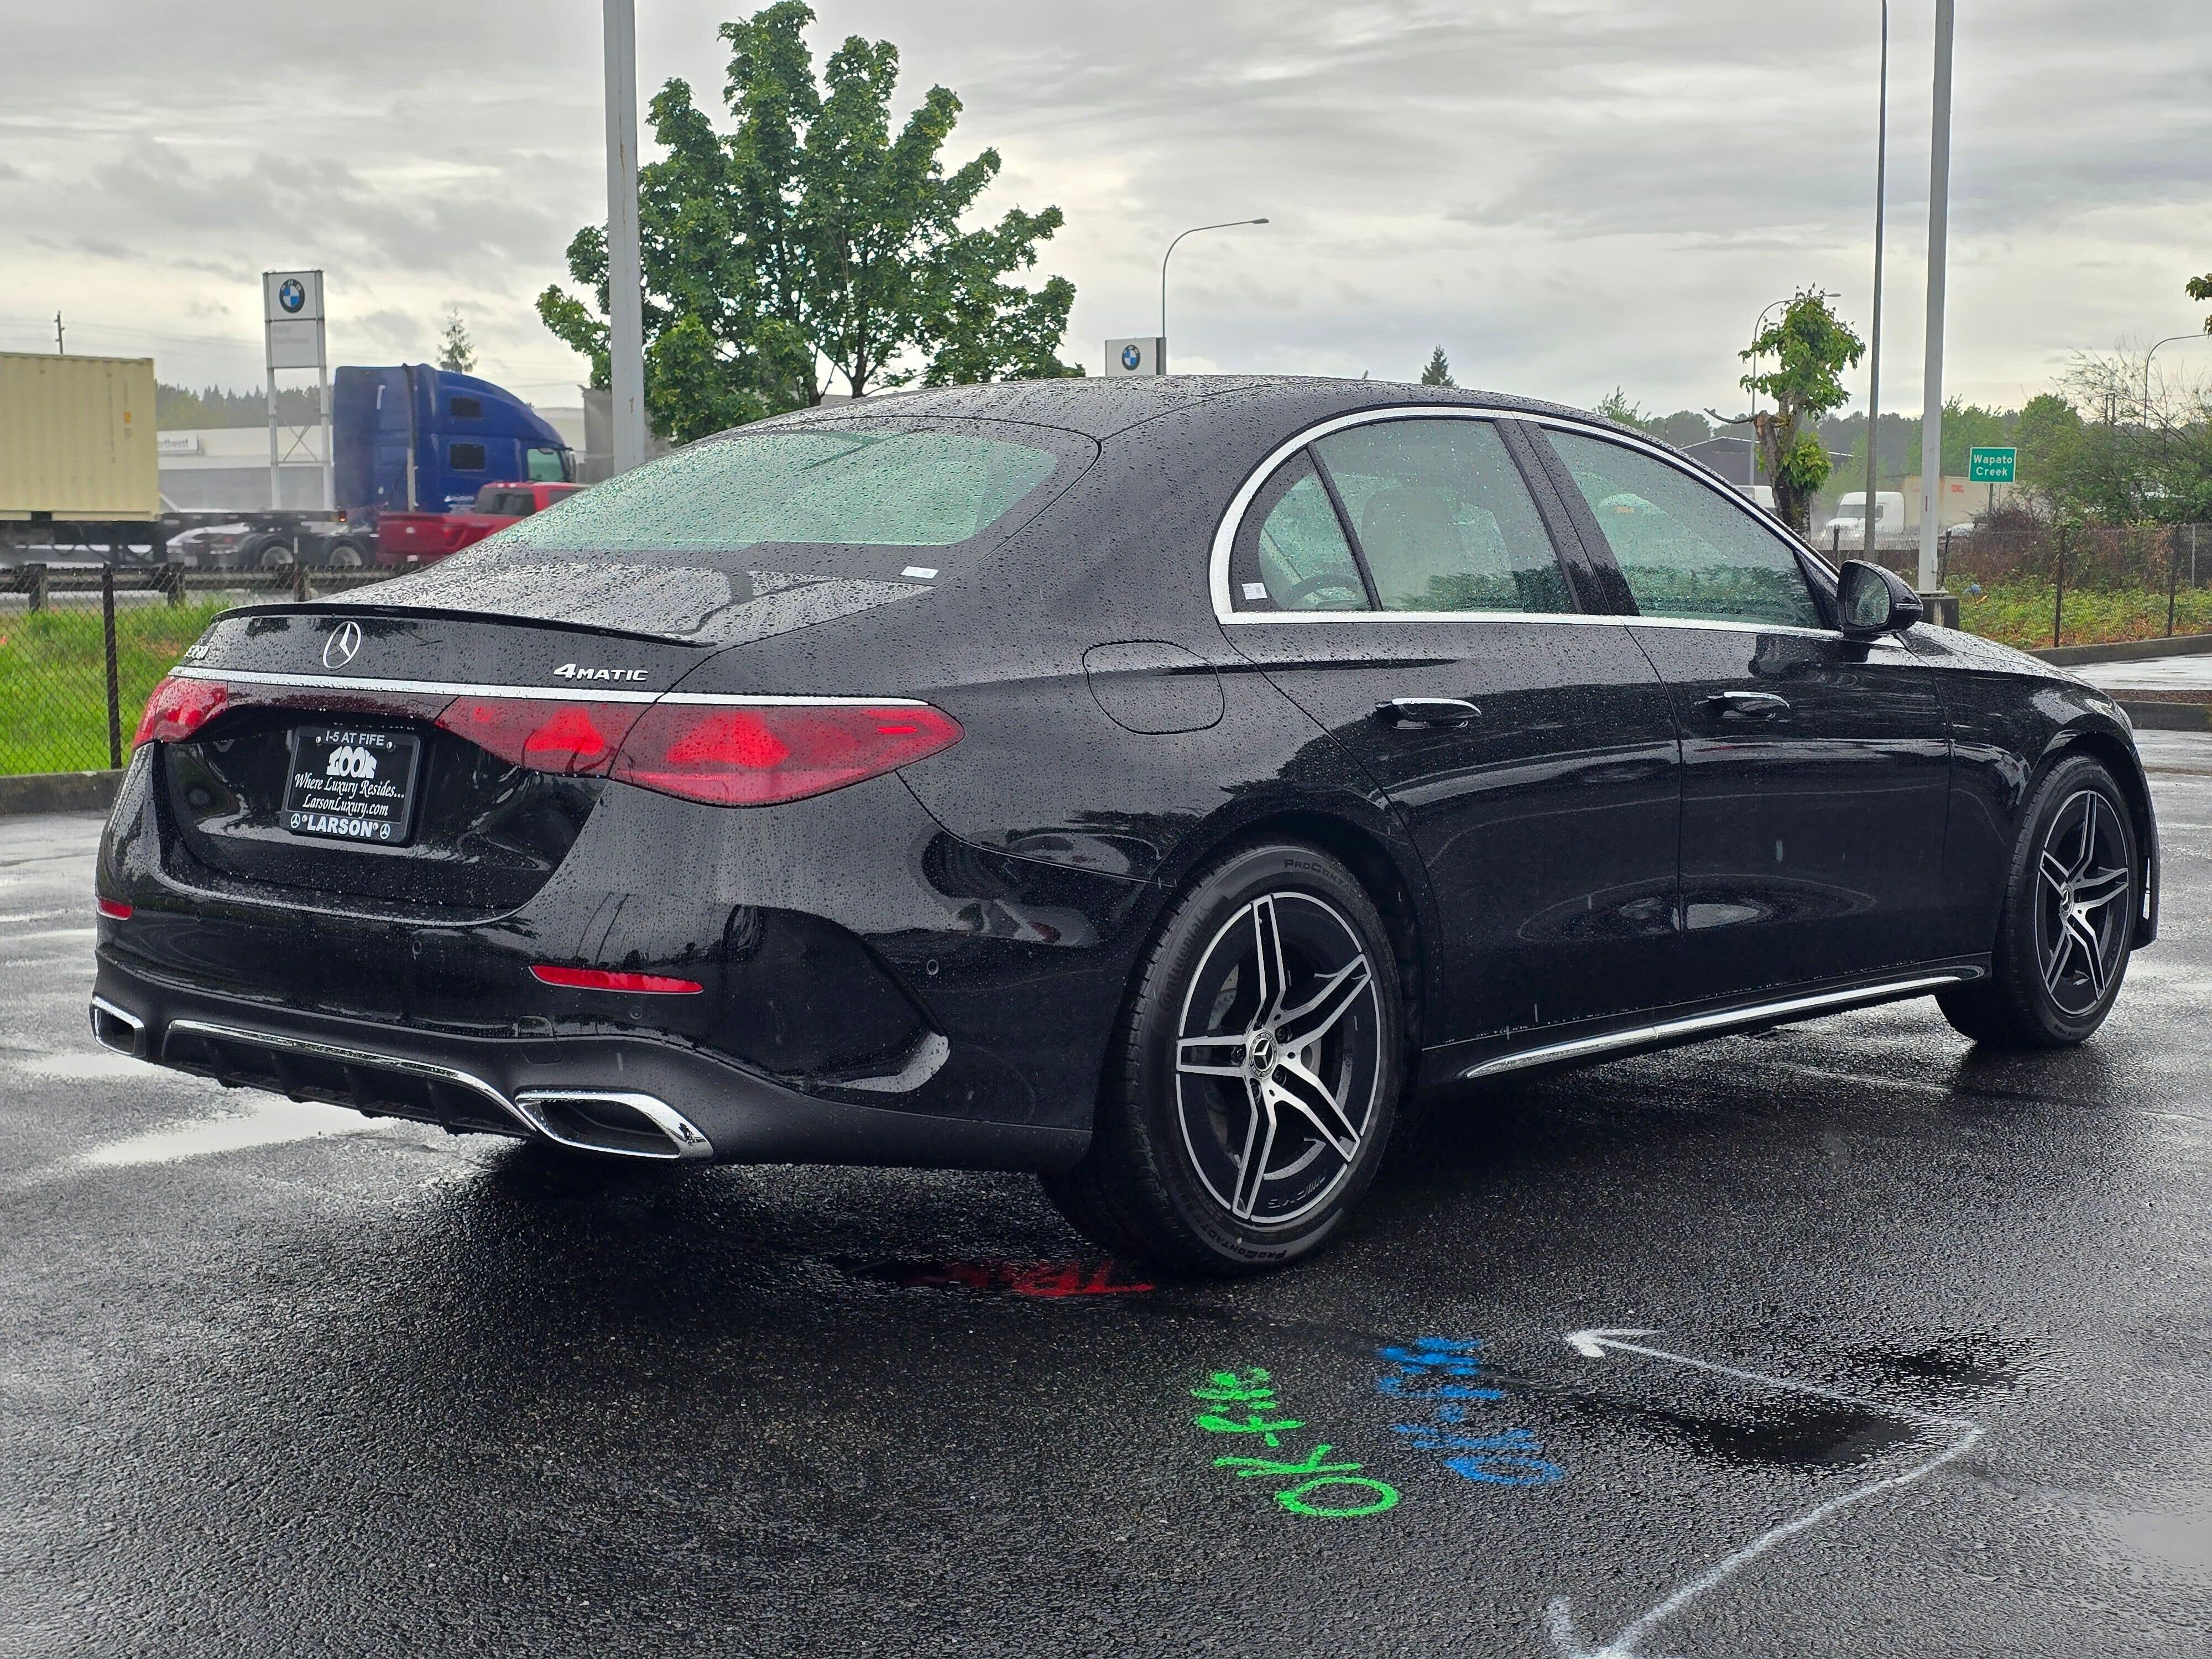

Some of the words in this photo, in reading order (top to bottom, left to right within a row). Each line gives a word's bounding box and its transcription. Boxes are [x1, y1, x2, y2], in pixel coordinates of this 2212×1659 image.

[1974, 454, 2012, 466] Wapato
[1976, 467, 2007, 476] Creek
[554, 663, 649, 681] 4MATIC
[326, 730, 340, 742] I-5
[341, 732, 357, 744] AT
[358, 733, 385, 746] FIFE
[295, 771, 323, 790] Where
[324, 776, 358, 800] Luxury
[359, 780, 404, 799] Resides...
[302, 793, 389, 818] LarsonLuxury.com
[306, 814, 373, 838] LARSON
